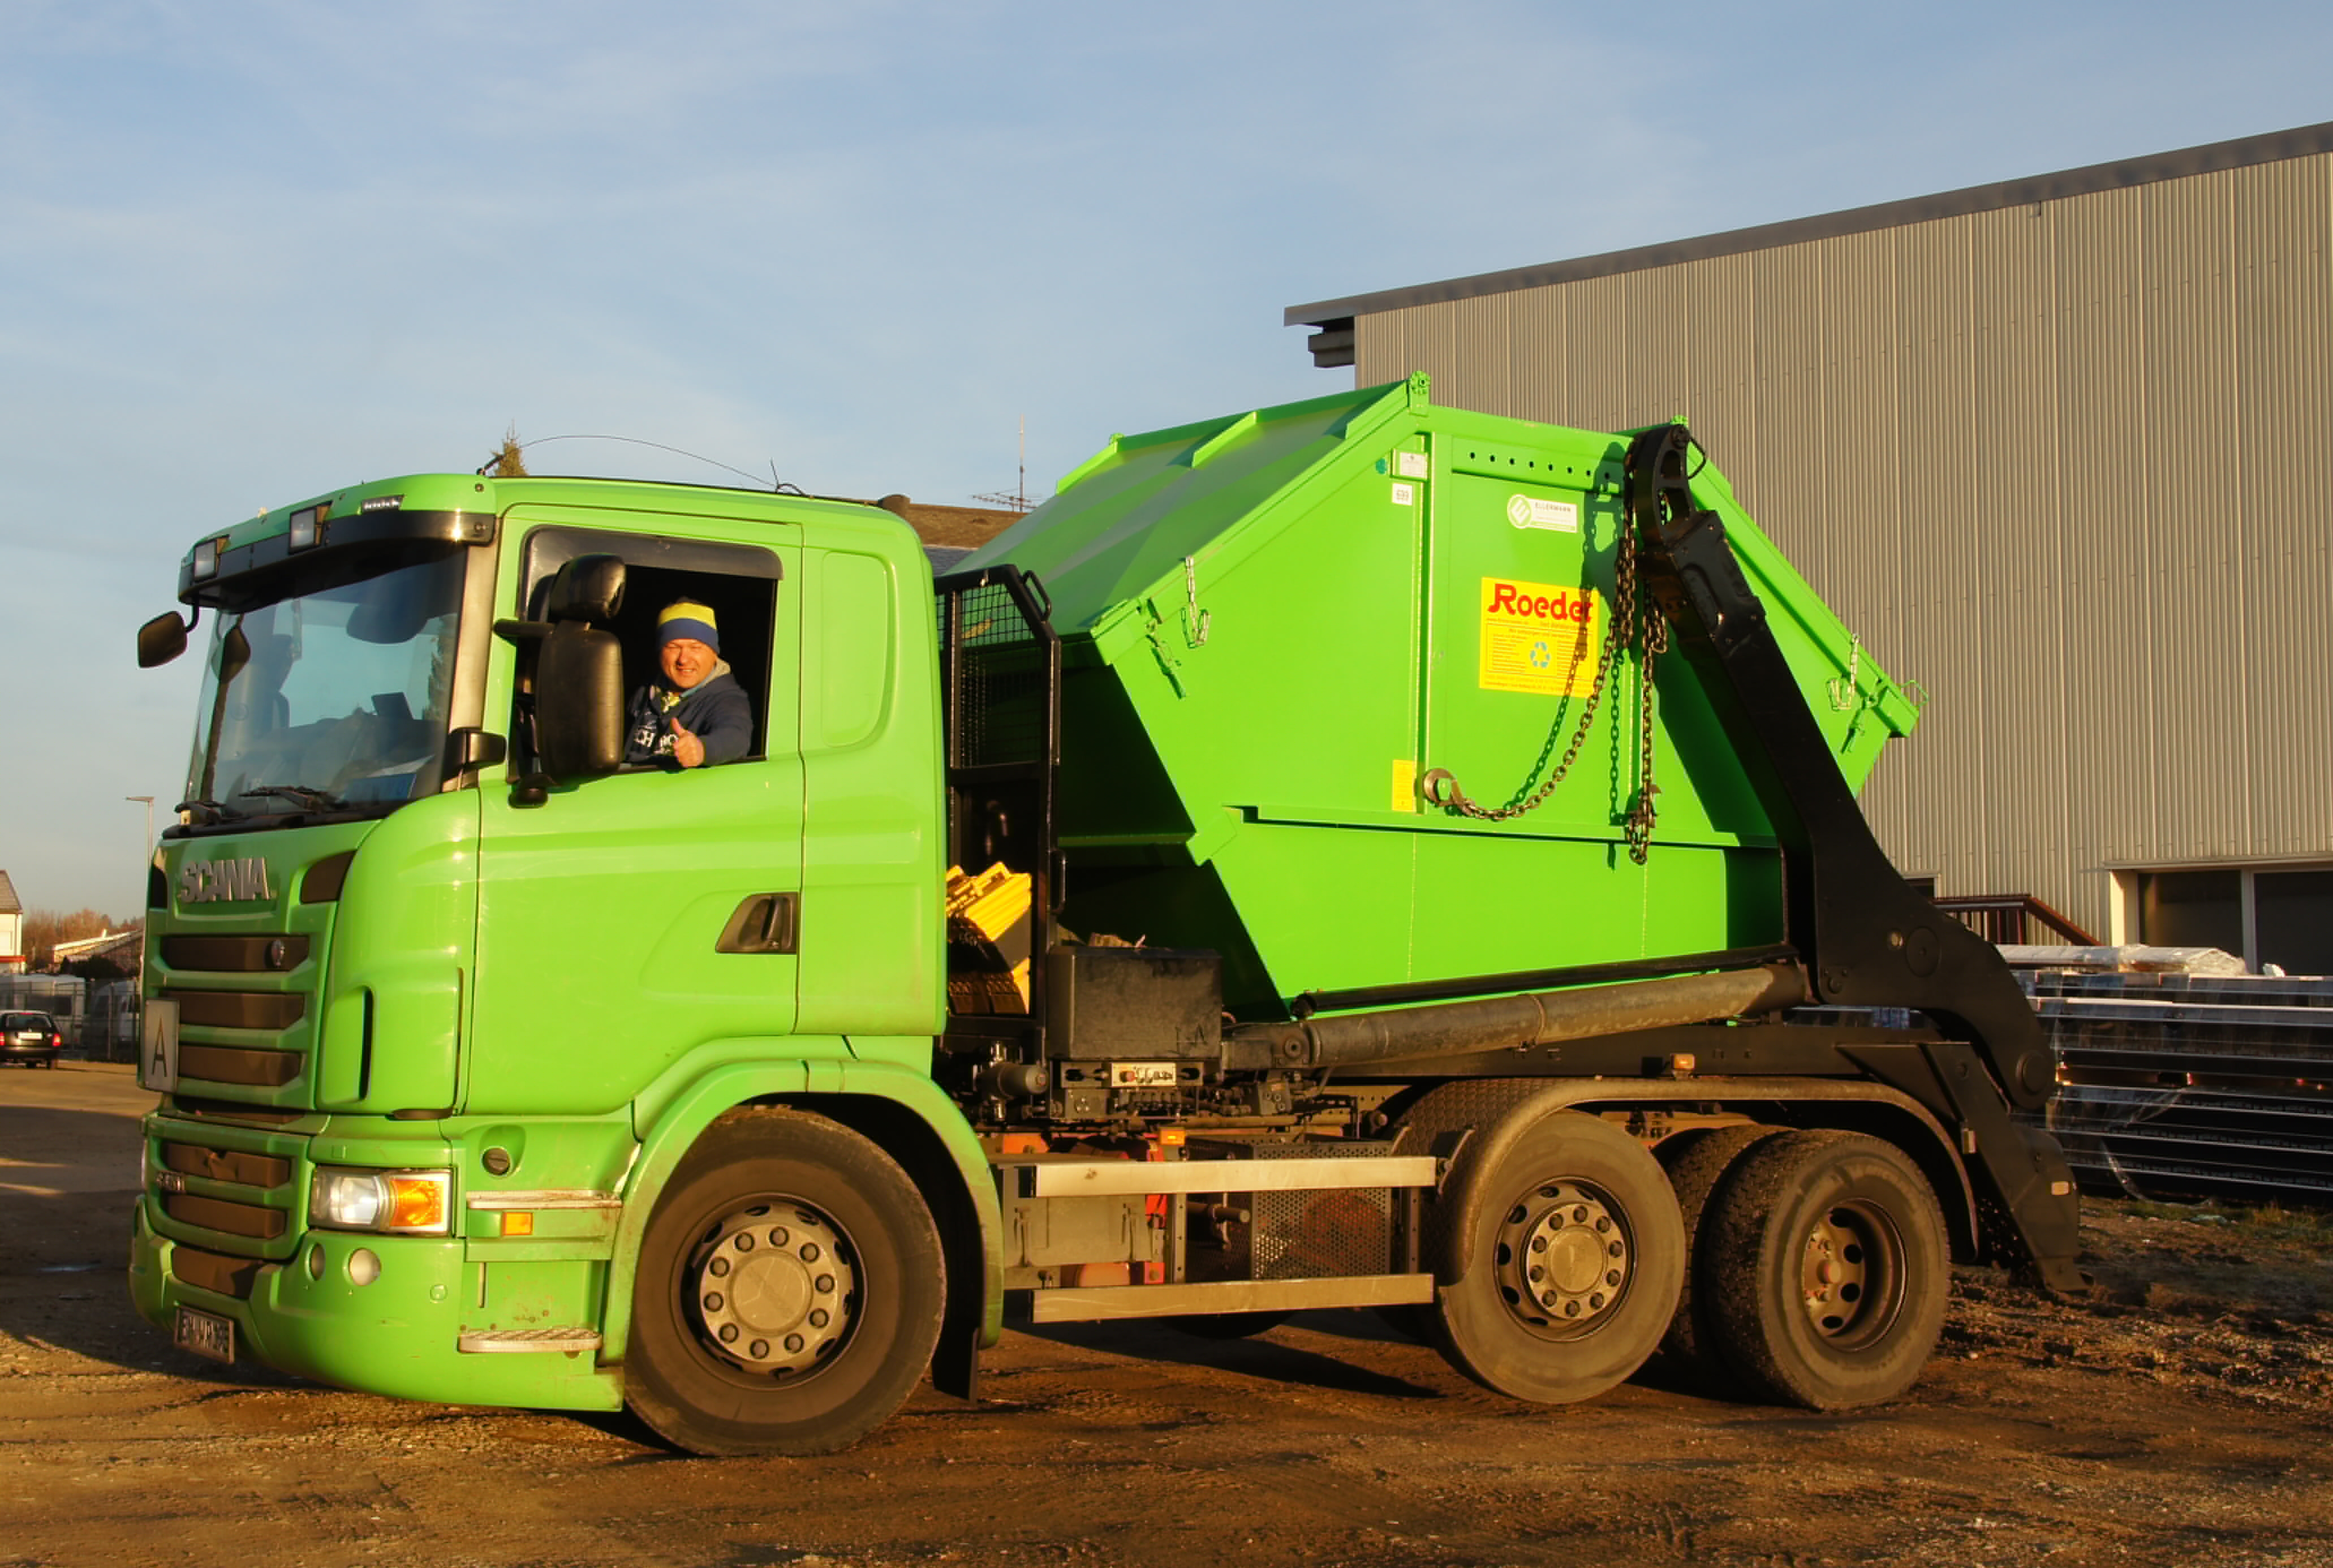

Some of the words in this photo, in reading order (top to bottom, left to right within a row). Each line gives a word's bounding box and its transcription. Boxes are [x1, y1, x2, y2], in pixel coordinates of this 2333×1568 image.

[1487, 583, 1593, 623] Roeder
[180, 858, 270, 902] SCANIA
[151, 1015, 168, 1078] A
